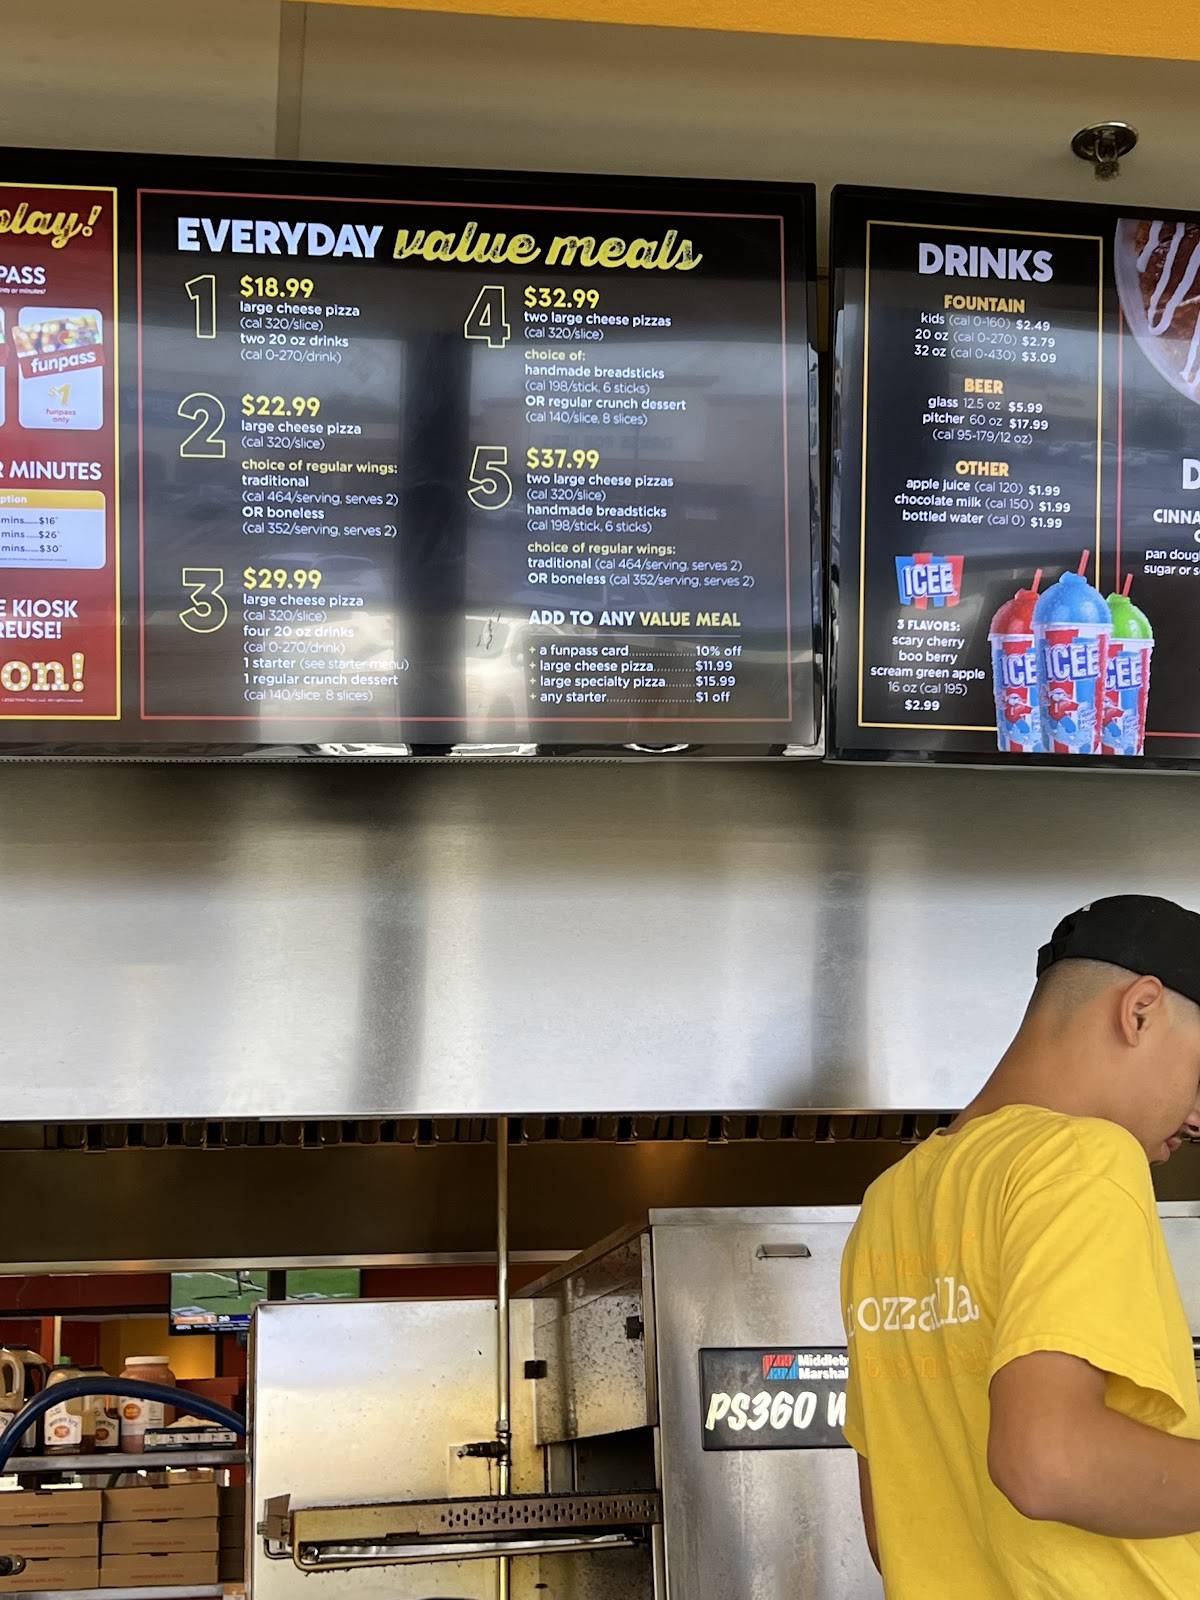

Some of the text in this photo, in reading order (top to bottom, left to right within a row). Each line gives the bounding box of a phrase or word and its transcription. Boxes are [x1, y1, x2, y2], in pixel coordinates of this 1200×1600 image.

[178, 217, 703, 270] EVERYDAY value meals
[919, 243, 1053, 282] DRINKS
[185, 274, 315, 339] 1 $18.99
[240, 301, 360, 317] large cheese pizza
[944, 295, 1025, 313] FOUNTAIN
[464, 286, 600, 348] 4 $32.99
[524, 312, 672, 328] two large cheese pizzas
[921, 312, 1050, 331] kids $2.49
[240, 334, 349, 347] two 20 oz drinks
[915, 329, 1055, 347] 20 oz $2.79
[525, 349, 585, 361] choice of:
[914, 345, 1056, 363] 32 oz $3.09
[31, 352, 96, 372] funpass
[525, 364, 665, 379] handmade breadsticks
[964, 378, 1004, 394] BEER
[525, 396, 686, 410] OR regular crunch dessert
[928, 396, 958, 409] glass
[987, 401, 1000, 410] oz
[1008, 402, 1043, 413] $5.99
[177, 392, 320, 458] 2 $22.99
[241, 420, 361, 435] large cheese pizza
[923, 413, 1049, 430] pitcher 60 oz $17.99
[9, 460, 102, 480] MINUTES
[242, 460, 398, 473] choice of regular wings:
[955, 460, 1009, 477] OTHER
[242, 475, 309, 487] traditional
[468, 446, 600, 510] 5 $37.99
[527, 473, 674, 488] two large cheese pizzas
[906, 478, 1060, 496] apple juice $1.99
[894, 493, 1071, 513] chocolate milk $1.99
[242, 507, 324, 519] OR boneless
[527, 504, 667, 518] handmade breadsticks
[902, 509, 1063, 529] bottled water $1.99
[528, 542, 676, 556] choice of regular wings:
[1145, 549, 1166, 561] pan
[528, 558, 592, 569] traditional
[1144, 564, 1191, 576] sugar or
[528, 573, 606, 585] OR boneless
[904, 563, 954, 595] ICEE
[179, 567, 322, 633] 3 $29.99
[243, 593, 363, 607] large cheese pizza
[13, 599, 78, 618] KIOSK
[528, 611, 741, 627] ADD TO ANY VALUE MEAL
[897, 619, 960, 631] 3 FLAVORS:
[243, 625, 354, 638] four 20 oz drinks
[892, 636, 965, 649] scary cherry
[540, 645, 742, 659] a funpass card 10% off
[899, 650, 957, 665] boo berry
[244, 657, 296, 669] 1 starter
[540, 660, 732, 674] large cheese pizza $11.99
[1044, 642, 1099, 681] ICEE
[244, 673, 398, 686] 1 regular crunch dessert
[871, 667, 985, 681] scream green apple
[540, 676, 735, 689] large specialty pizza $15.99
[540, 692, 730, 704] any starter $1 off
[905, 700, 940, 711] $2.99
[798, 1354, 849, 1367] Middleb
[705, 1391, 817, 1431] PS360
